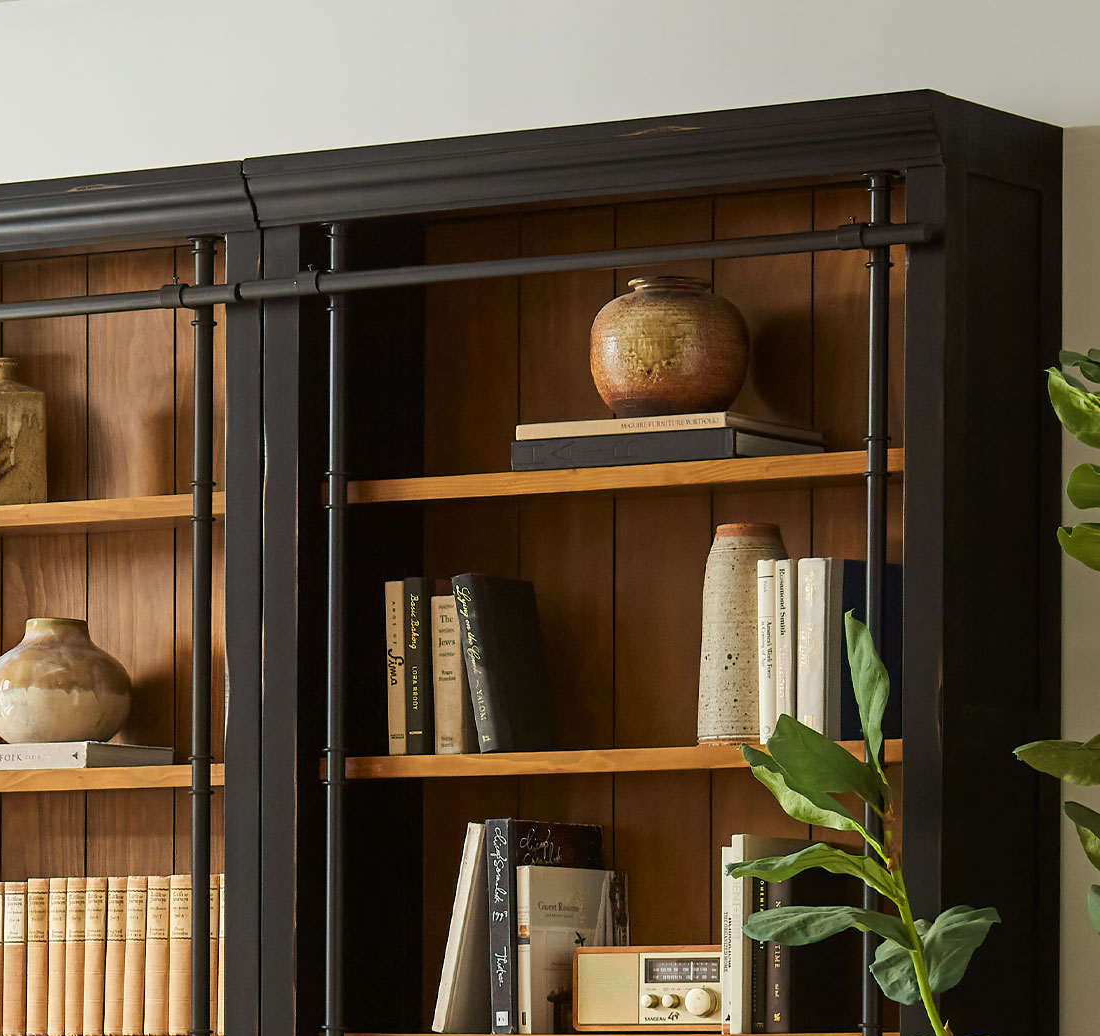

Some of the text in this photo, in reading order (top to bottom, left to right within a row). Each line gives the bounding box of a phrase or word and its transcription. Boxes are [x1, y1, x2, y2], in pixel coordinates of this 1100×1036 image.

[454, 585, 472, 618] Lying
[408, 593, 420, 650] Basic Baking
[440, 614, 454, 623] The
[464, 619, 472, 631] on
[438, 637, 456, 648] Jews
[467, 632, 477, 645] the
[387, 648, 405, 687] Fima
[537, 901, 580, 912] Guest Rooms
